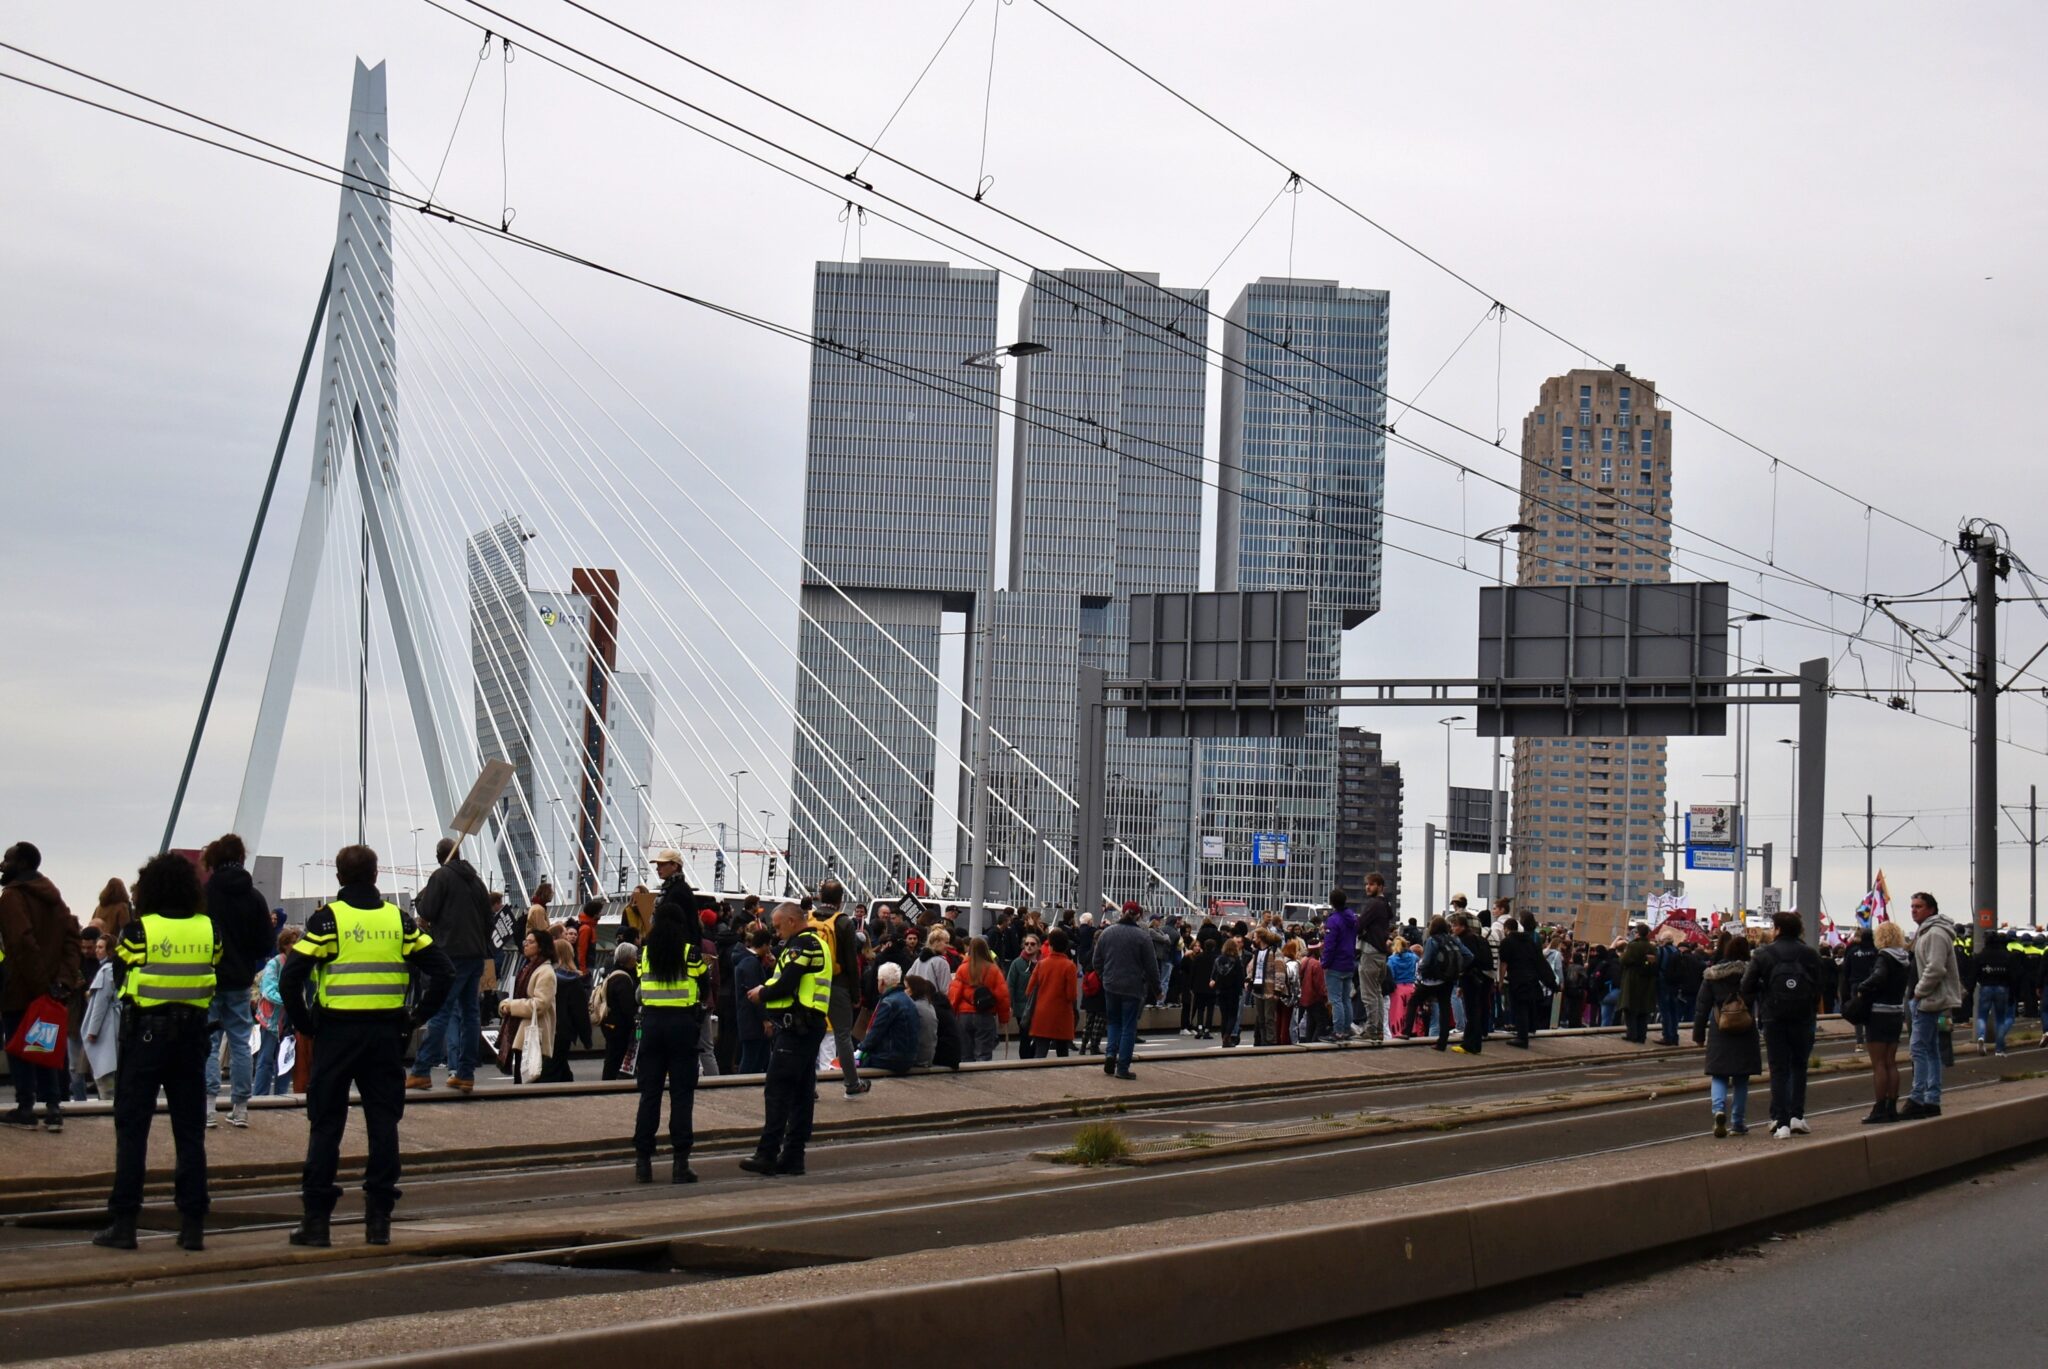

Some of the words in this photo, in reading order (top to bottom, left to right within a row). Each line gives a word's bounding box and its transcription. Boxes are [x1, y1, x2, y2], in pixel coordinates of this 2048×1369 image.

[559, 612, 585, 626] kpn
[345, 926, 400, 942] POLITIE
[152, 940, 210, 957] POLITIE
